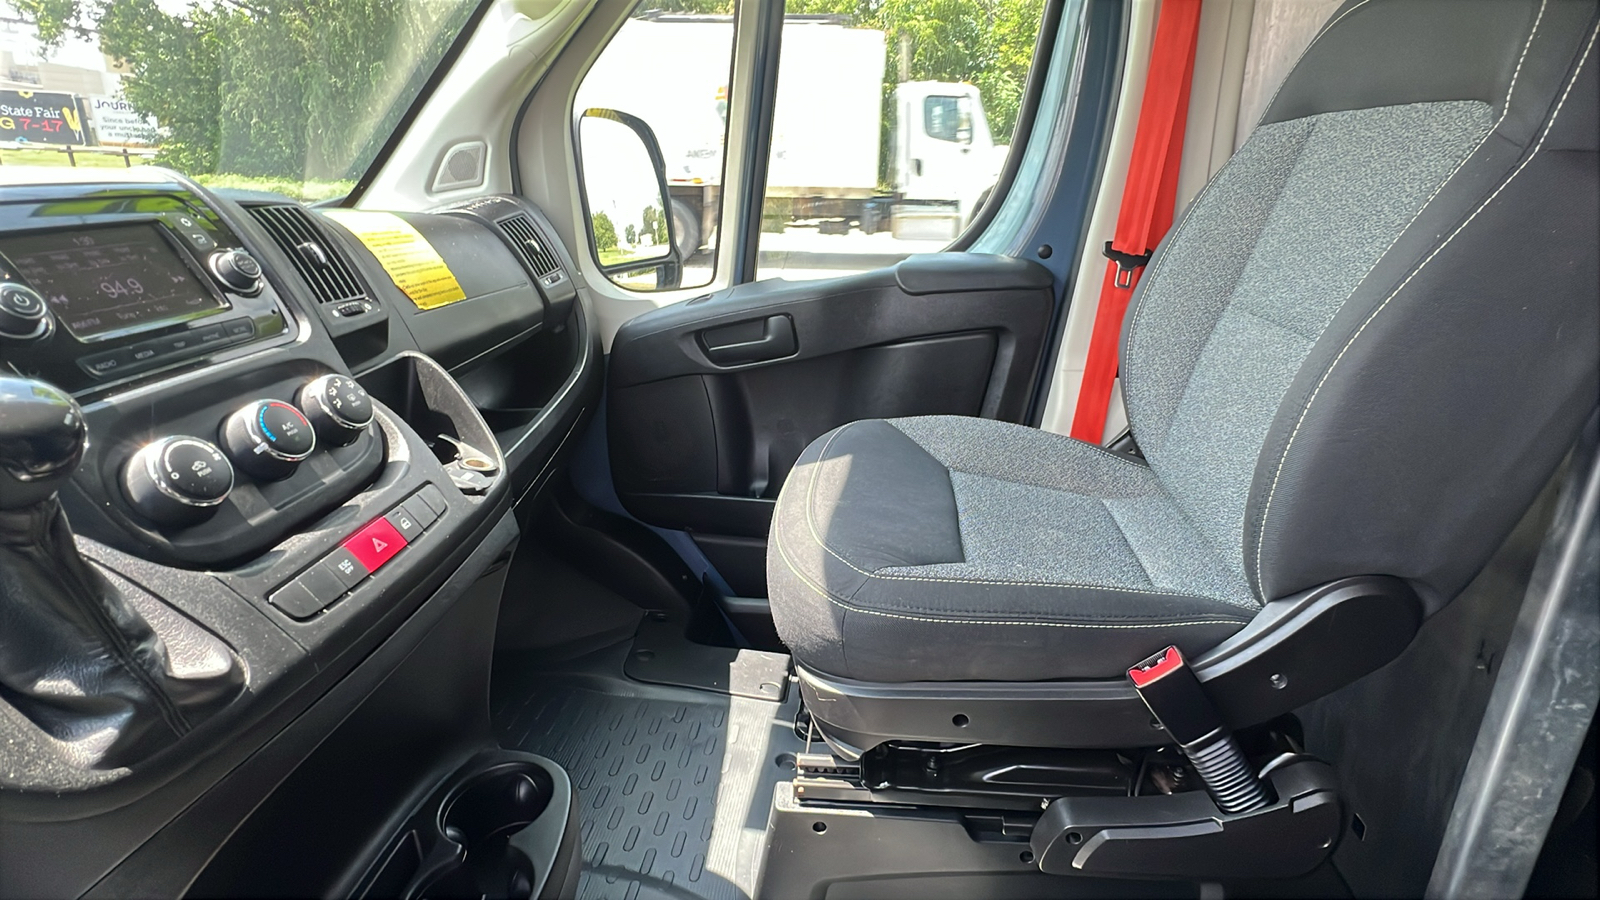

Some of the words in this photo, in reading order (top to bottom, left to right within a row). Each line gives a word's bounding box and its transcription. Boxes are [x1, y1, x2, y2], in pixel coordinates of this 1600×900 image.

[0, 104, 33, 117] State
[34, 107, 60, 119] Fair
[19, 118, 63, 132] 7-17
[101, 278, 144, 298] 94.9
[95, 360, 117, 370] RADIO
[134, 350, 155, 359] MEDIA
[282, 421, 294, 430] A/C
